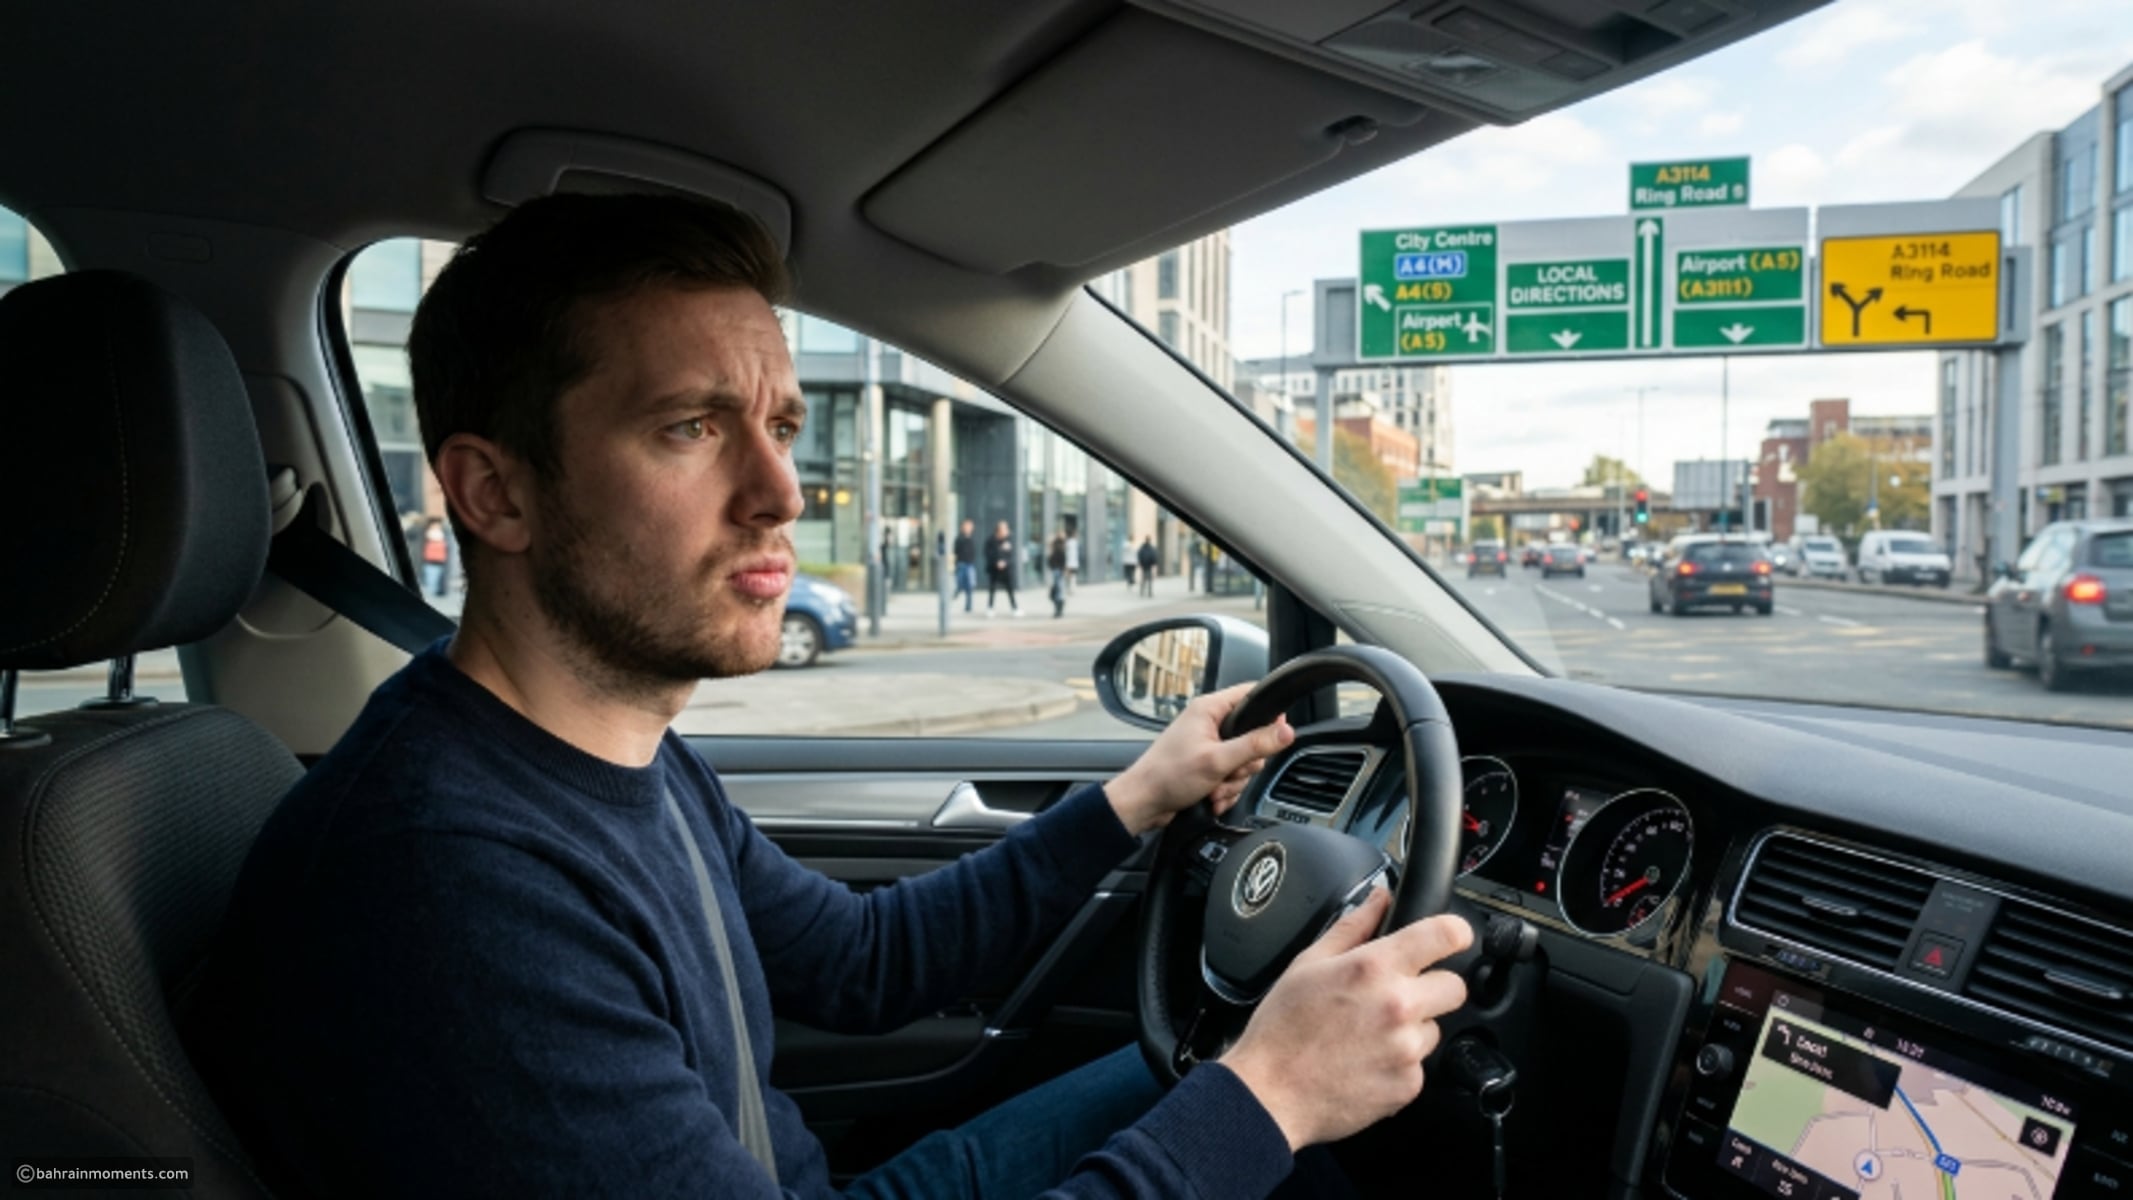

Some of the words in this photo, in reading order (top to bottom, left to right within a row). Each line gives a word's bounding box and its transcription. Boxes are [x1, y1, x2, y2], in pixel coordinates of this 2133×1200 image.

[1656, 164, 1711, 184] A3114
[1635, 187, 1676, 206] Ring
[1681, 182, 1728, 202] Road
[1395, 233, 1431, 250] City
[1434, 231, 1493, 248] Centre
[1891, 242, 1951, 260] A3114
[1681, 253, 1746, 275] Airport
[1890, 264, 1934, 283] Ring
[1941, 261, 1991, 279] Road
[1537, 265, 1598, 284] LOCAL
[1511, 282, 1625, 304] DIRECTIONS
[1402, 311, 1462, 331] Airport
